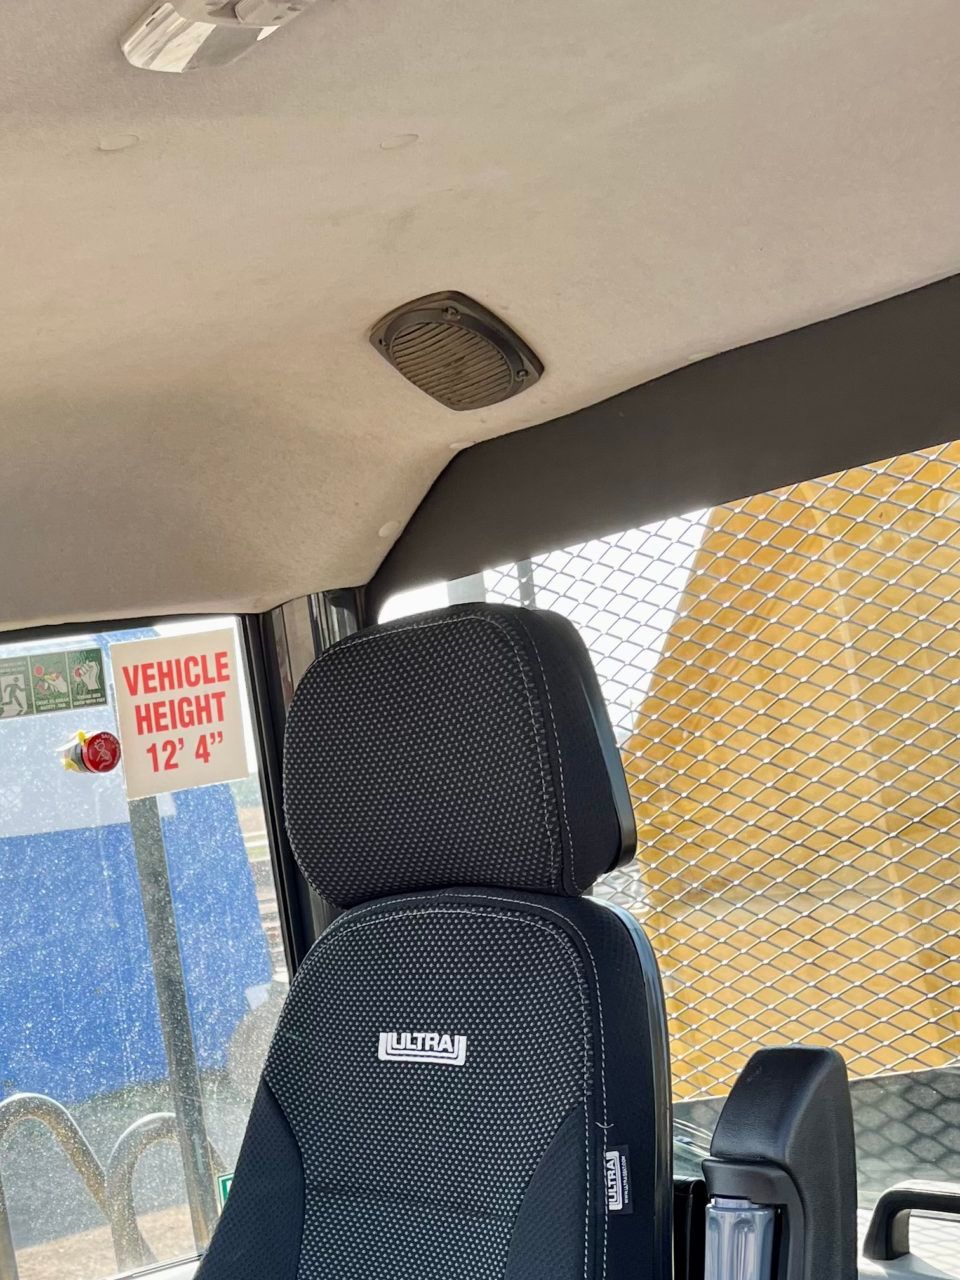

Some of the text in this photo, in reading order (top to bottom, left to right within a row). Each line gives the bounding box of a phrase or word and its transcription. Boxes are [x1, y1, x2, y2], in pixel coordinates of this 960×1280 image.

[122, 651, 231, 697] VEHICLE
[134, 691, 227, 736] HEIGHT
[146, 736, 185, 773] 12'
[391, 1032, 455, 1053] ULTRA
